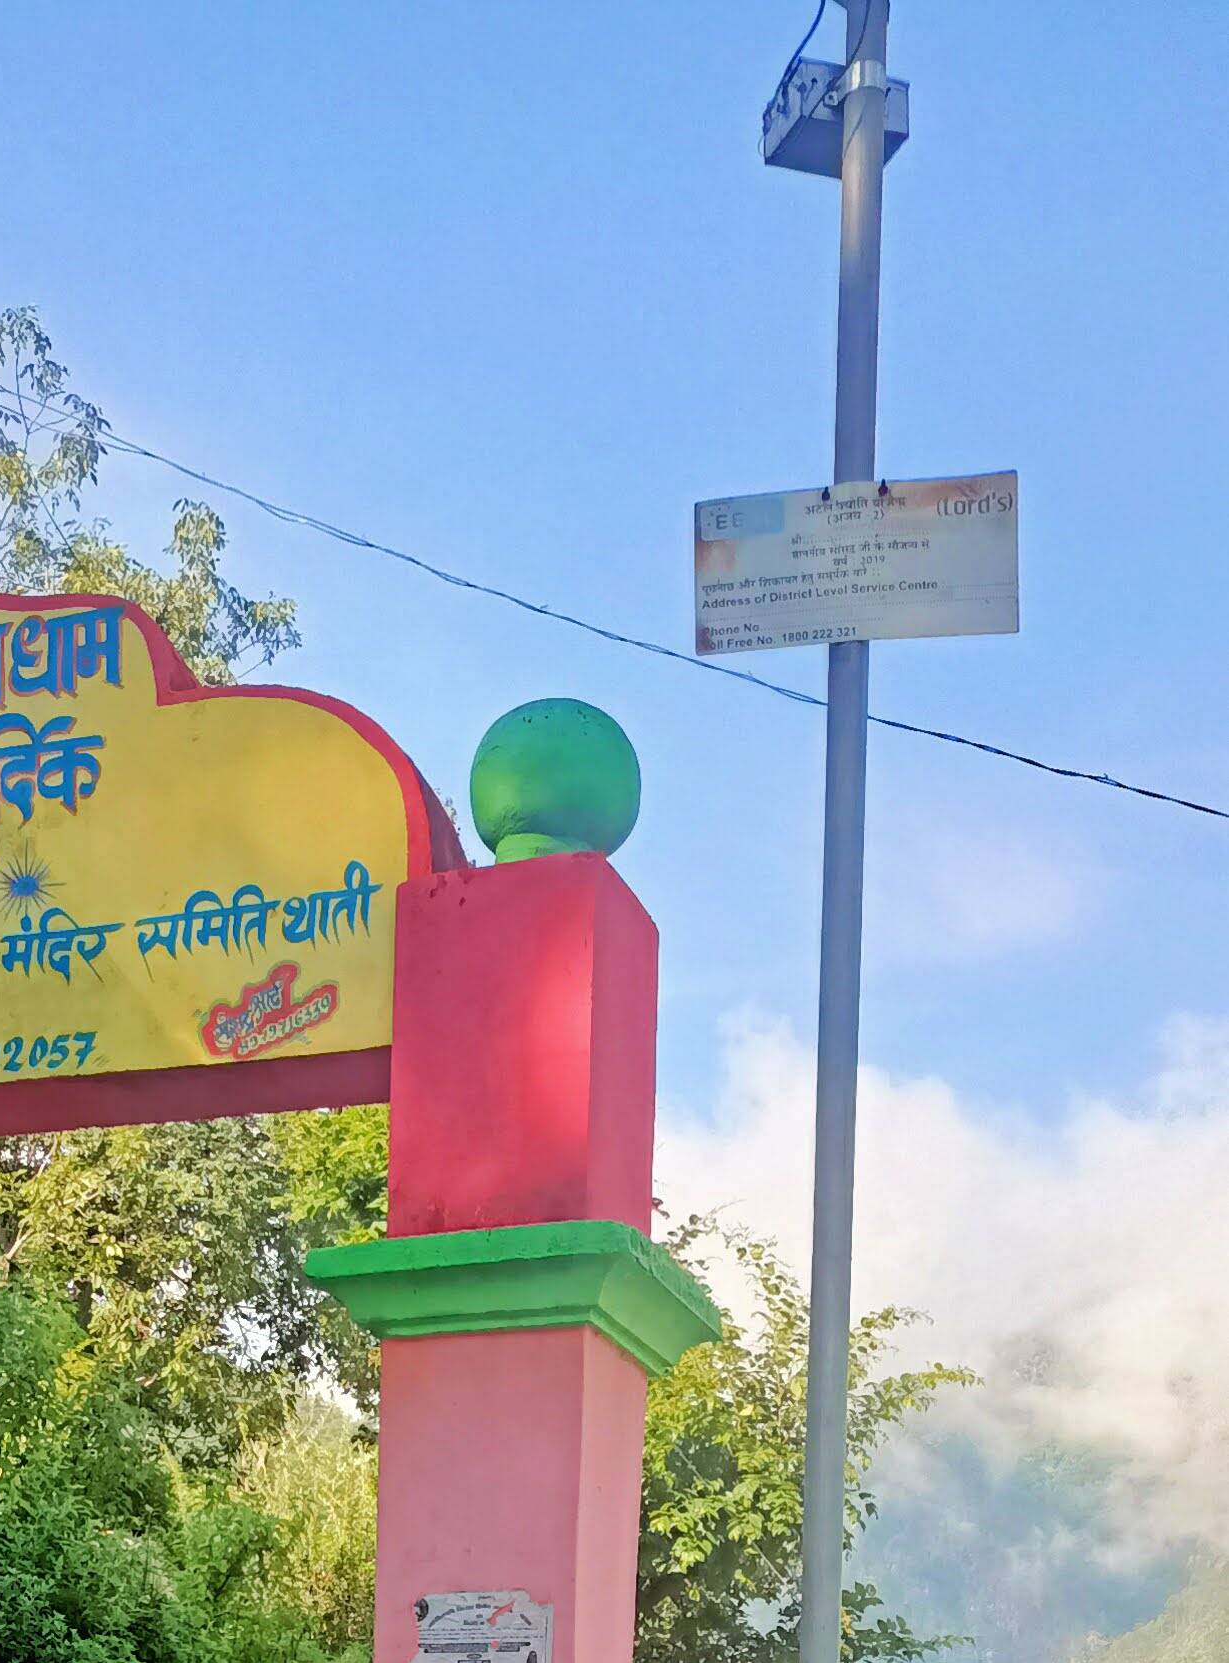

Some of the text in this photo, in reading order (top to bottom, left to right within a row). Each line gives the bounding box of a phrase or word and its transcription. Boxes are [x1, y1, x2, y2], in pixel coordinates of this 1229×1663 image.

[936, 492, 1013, 517] (Lord's)
[860, 555, 885, 567] 2019
[701, 580, 939, 609] Address of District Level Service Centre
[727, 637, 753, 649] Free
[782, 631, 809, 643] 1800
[812, 629, 833, 639] 222
[836, 626, 857, 638] 321
[0, 907, 125, 985] मंदिर
[134, 884, 281, 983] समिति
[282, 860, 383, 951] थाती
